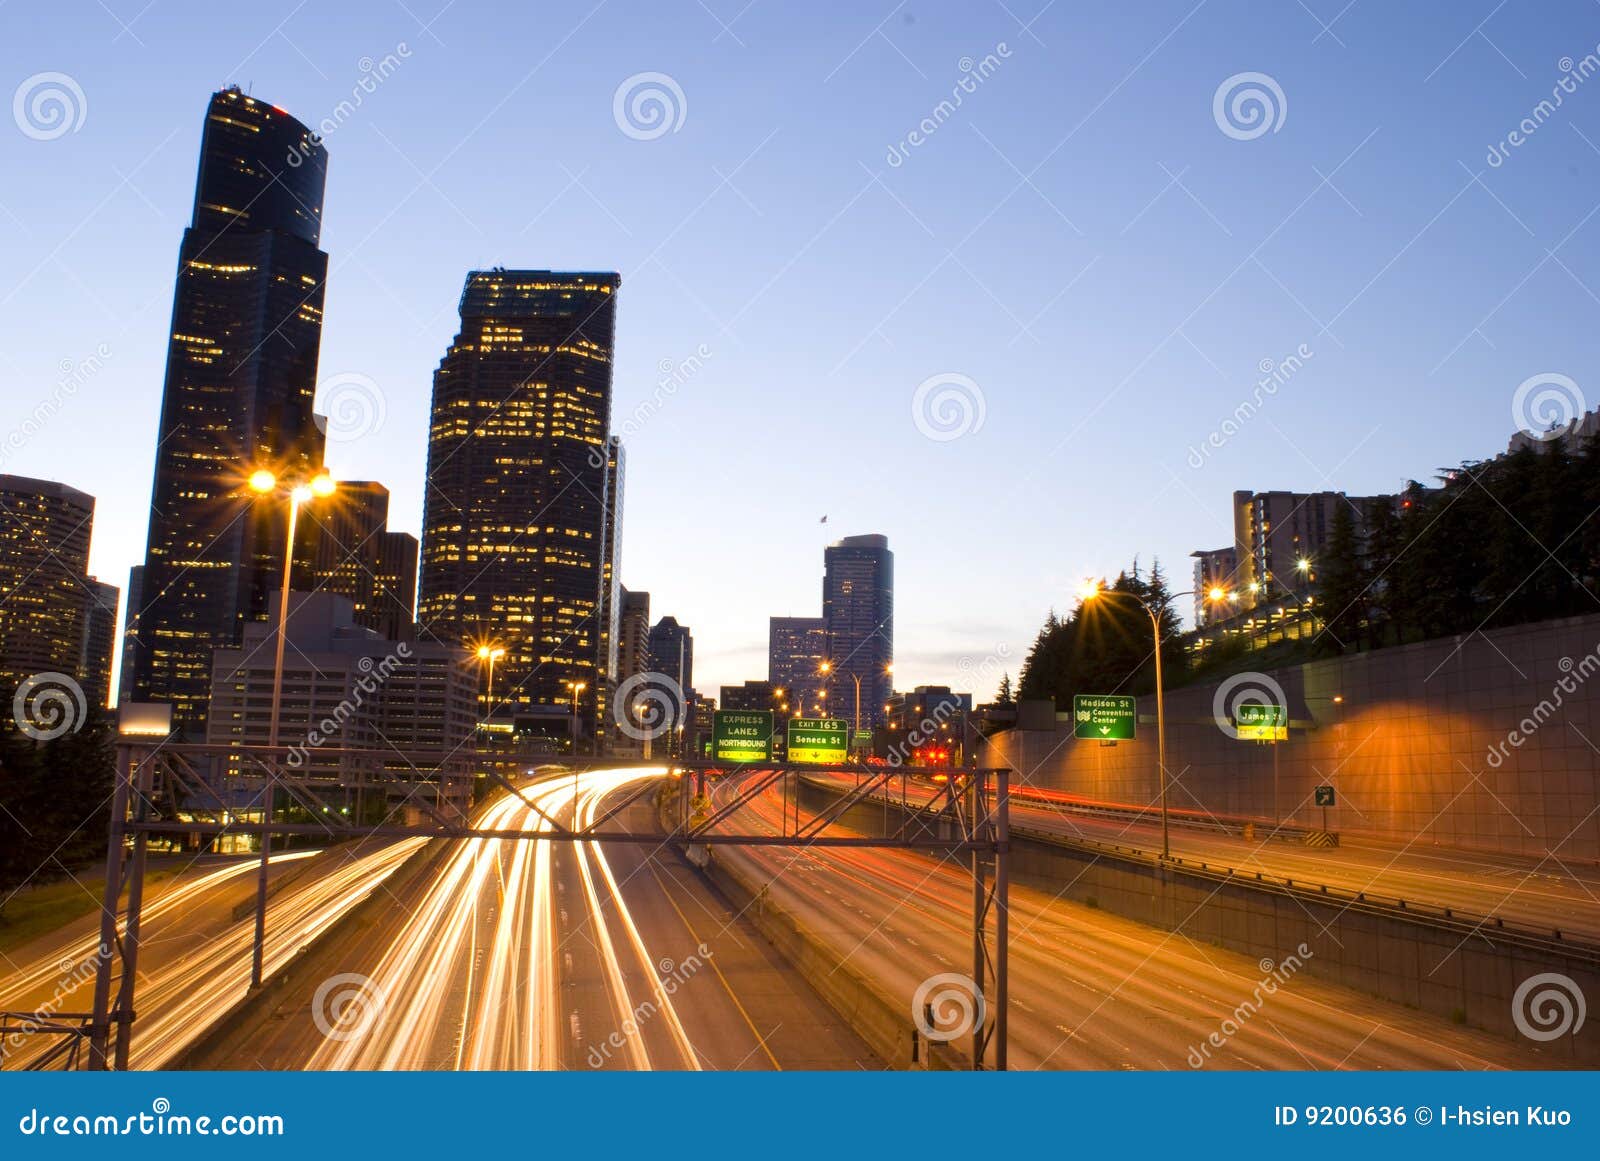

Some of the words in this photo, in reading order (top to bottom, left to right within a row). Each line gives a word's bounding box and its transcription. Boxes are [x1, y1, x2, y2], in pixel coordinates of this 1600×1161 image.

[722, 715, 764, 724] EXPRESS
[820, 722, 838, 730] 165
[728, 728, 758, 736] LANES
[719, 739, 767, 748] NORTHBOUND
[795, 735, 827, 744] Seneca
[830, 736, 841, 745] St
